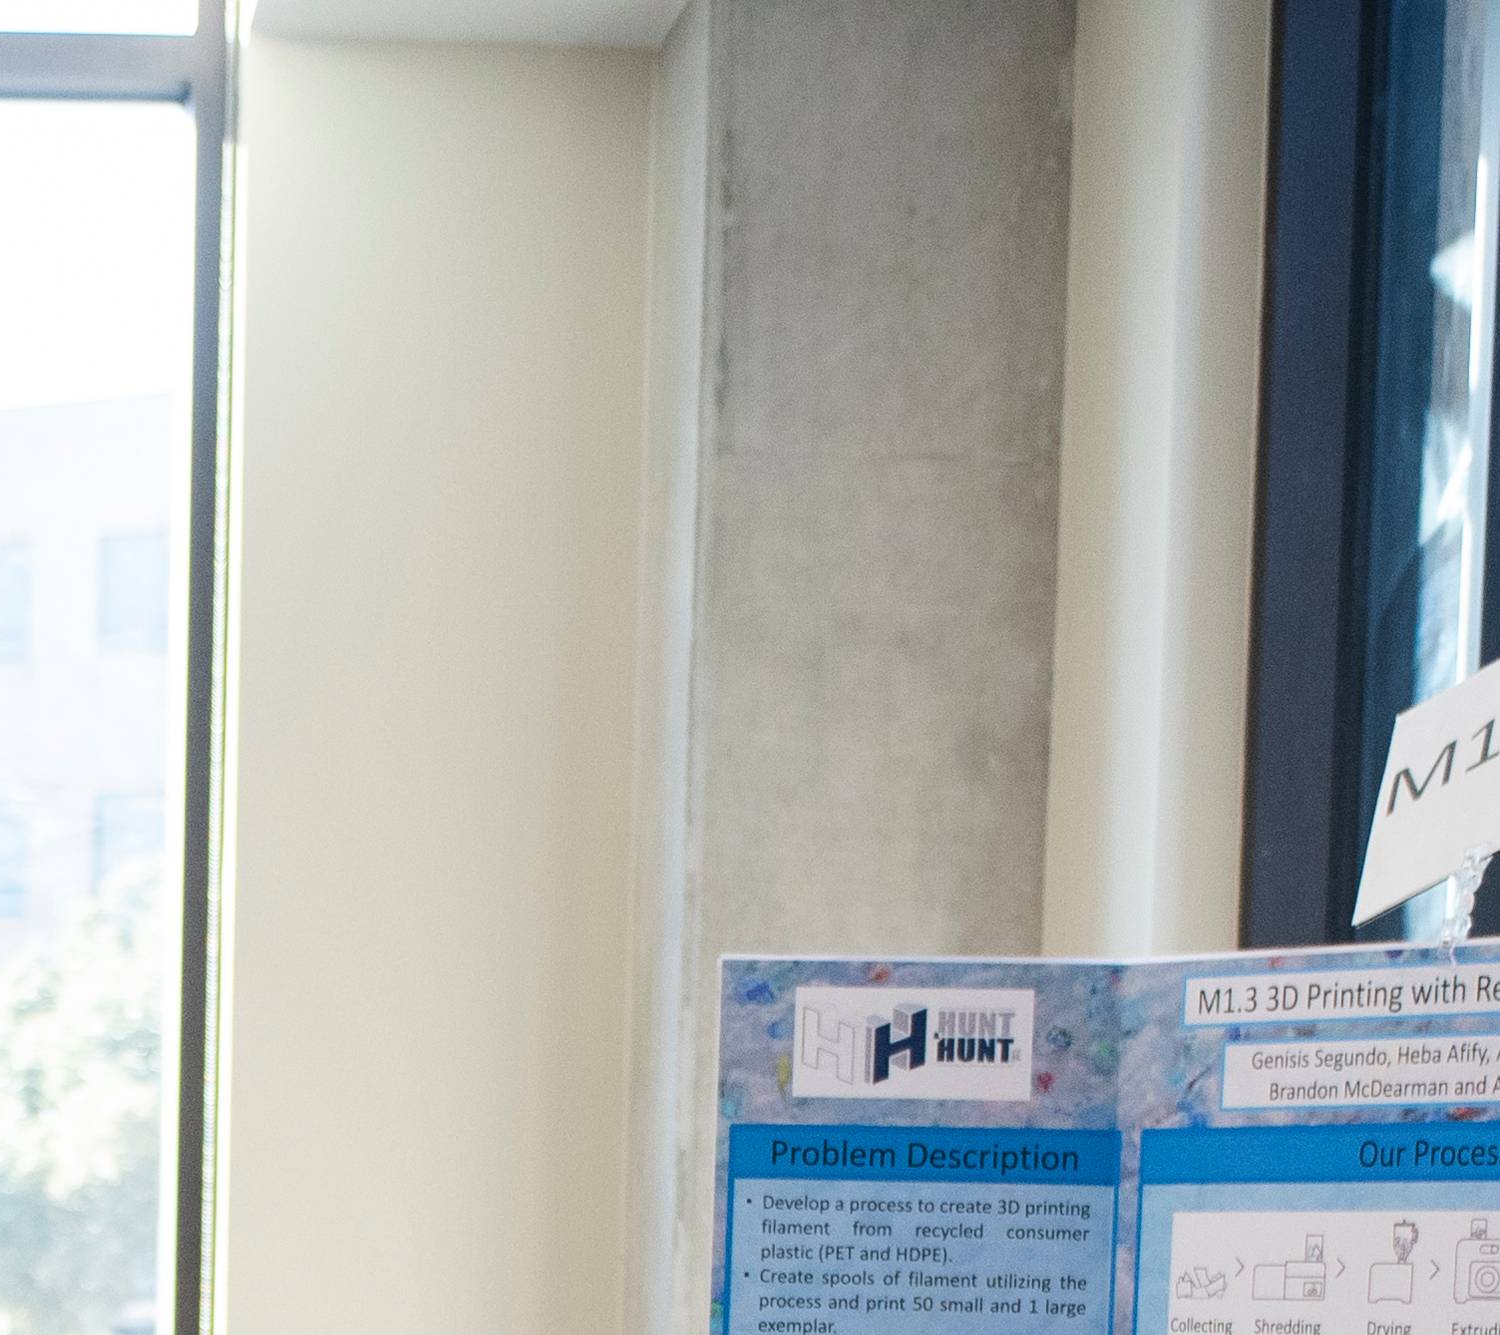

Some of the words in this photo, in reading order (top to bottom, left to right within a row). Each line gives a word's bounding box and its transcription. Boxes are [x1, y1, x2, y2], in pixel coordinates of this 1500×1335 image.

[1199, 987, 1257, 1014] M1.3
[1267, 985, 1298, 1011] 3D
[1308, 981, 1403, 1013] Printing
[1412, 975, 1466, 1004] with
[938, 1010, 1015, 1037] HUNT
[936, 1038, 1014, 1063] HUNT
[1252, 1051, 1309, 1070] Genisis
[1315, 1047, 1391, 1071] Segundo,
[1398, 1045, 1441, 1064] Heba
[1447, 1042, 1490, 1066] Afify,
[1270, 1081, 1338, 1100] Brandon
[1345, 1079, 1448, 1098] McDearman
[1454, 1075, 1487, 1095] and
[772, 1139, 895, 1167] Problem
[908, 1143, 1078, 1175] Description
[1359, 1140, 1406, 1168] Our
[763, 1195, 830, 1214] Develop
[835, 1200, 844, 1211] a
[850, 1200, 912, 1214] process
[918, 1199, 935, 1213] to
[940, 1201, 992, 1214] create
[998, 1199, 1020, 1215] 3D
[1025, 1201, 1090, 1220] printing
[762, 1219, 829, 1236] filament
[853, 1220, 892, 1236] from
[915, 1223, 984, 1241] recycled
[1006, 1228, 1090, 1241] consumer
[761, 1244, 813, 1261] plastic
[819, 1245, 855, 1263] (PET
[860, 1246, 890, 1261] and
[896, 1247, 952, 1265] HDPE).
[760, 1268, 813, 1284] Create
[822, 1271, 874, 1288] spools
[883, 1270, 901, 1286] of
[909, 1271, 977, 1288] filament
[986, 1273, 1051, 1293] utilizing
[1060, 1275, 1087, 1290] the
[759, 1296, 821, 1311] process
[829, 1294, 859, 1309] and
[866, 1298, 905, 1313] print
[913, 1296, 933, 1311] 50
[940, 1297, 983, 1312] small
[990, 1298, 1021, 1313] and
[1030, 1299, 1038, 1314] 1
[1046, 1299, 1086, 1318] large
[758, 1318, 836, 1335] exemplar.
